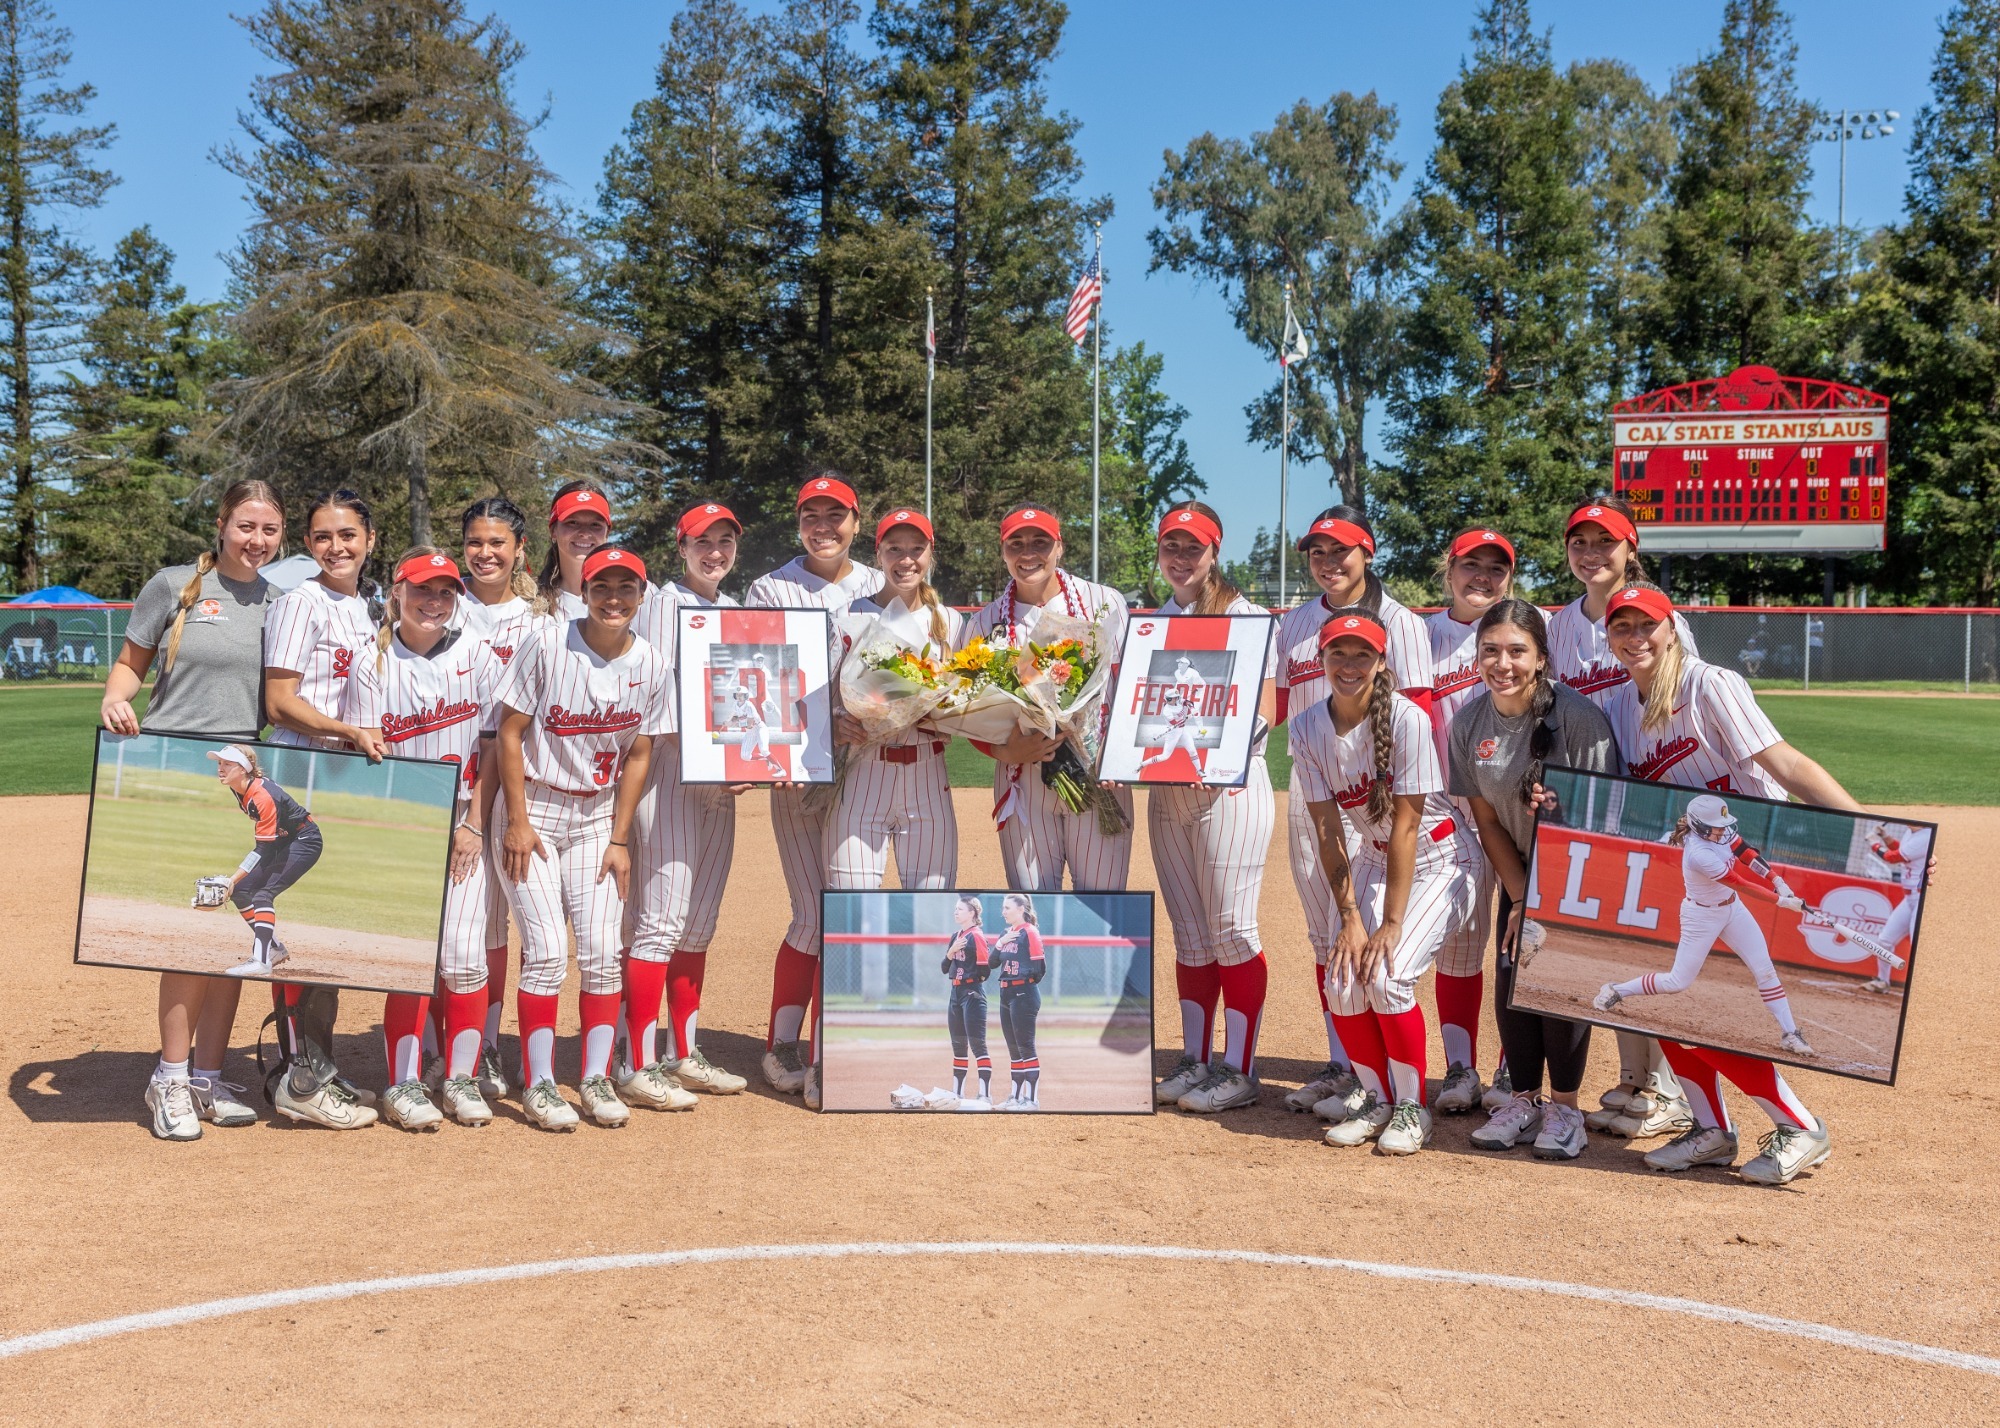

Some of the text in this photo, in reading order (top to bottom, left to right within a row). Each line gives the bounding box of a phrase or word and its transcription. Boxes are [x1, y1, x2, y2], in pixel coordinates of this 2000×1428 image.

[1628, 421, 1873, 442] CAL STATE STANISLAUS
[1620, 450, 1649, 462] AT BAT
[1683, 449, 1709, 461] BALL
[1737, 448, 1774, 460] STRIKE
[1801, 447, 1823, 459] OUT
[1855, 446, 1874, 457] H/E
[1690, 461, 1701, 478] 0
[1749, 460, 1760, 477] 0
[1807, 459, 1818, 476] 0
[1676, 480, 1681, 489] 1
[1687, 480, 1693, 489] 2
[1697, 480, 1704, 489] 3
[1713, 479, 1719, 488] 4
[1725, 479, 1731, 488] 5
[1752, 479, 1758, 488] 7
[1790, 478, 1798, 488] 10
[1807, 477, 1830, 487] RUNS
[1840, 477, 1859, 487] HITS
[1629, 489, 1651, 502] SSU
[1633, 507, 1656, 520] TAN
[1433, 659, 1480, 688] tanisl
[704, 667, 808, 732] ERB
[381, 698, 478, 736] Stanislaus
[545, 704, 641, 729] Stanislaus
[1804, 909, 1885, 936] WARRIOR
[1852, 933, 1893, 962] LOUISVILLE
[1004, 960, 1020, 975] 42
